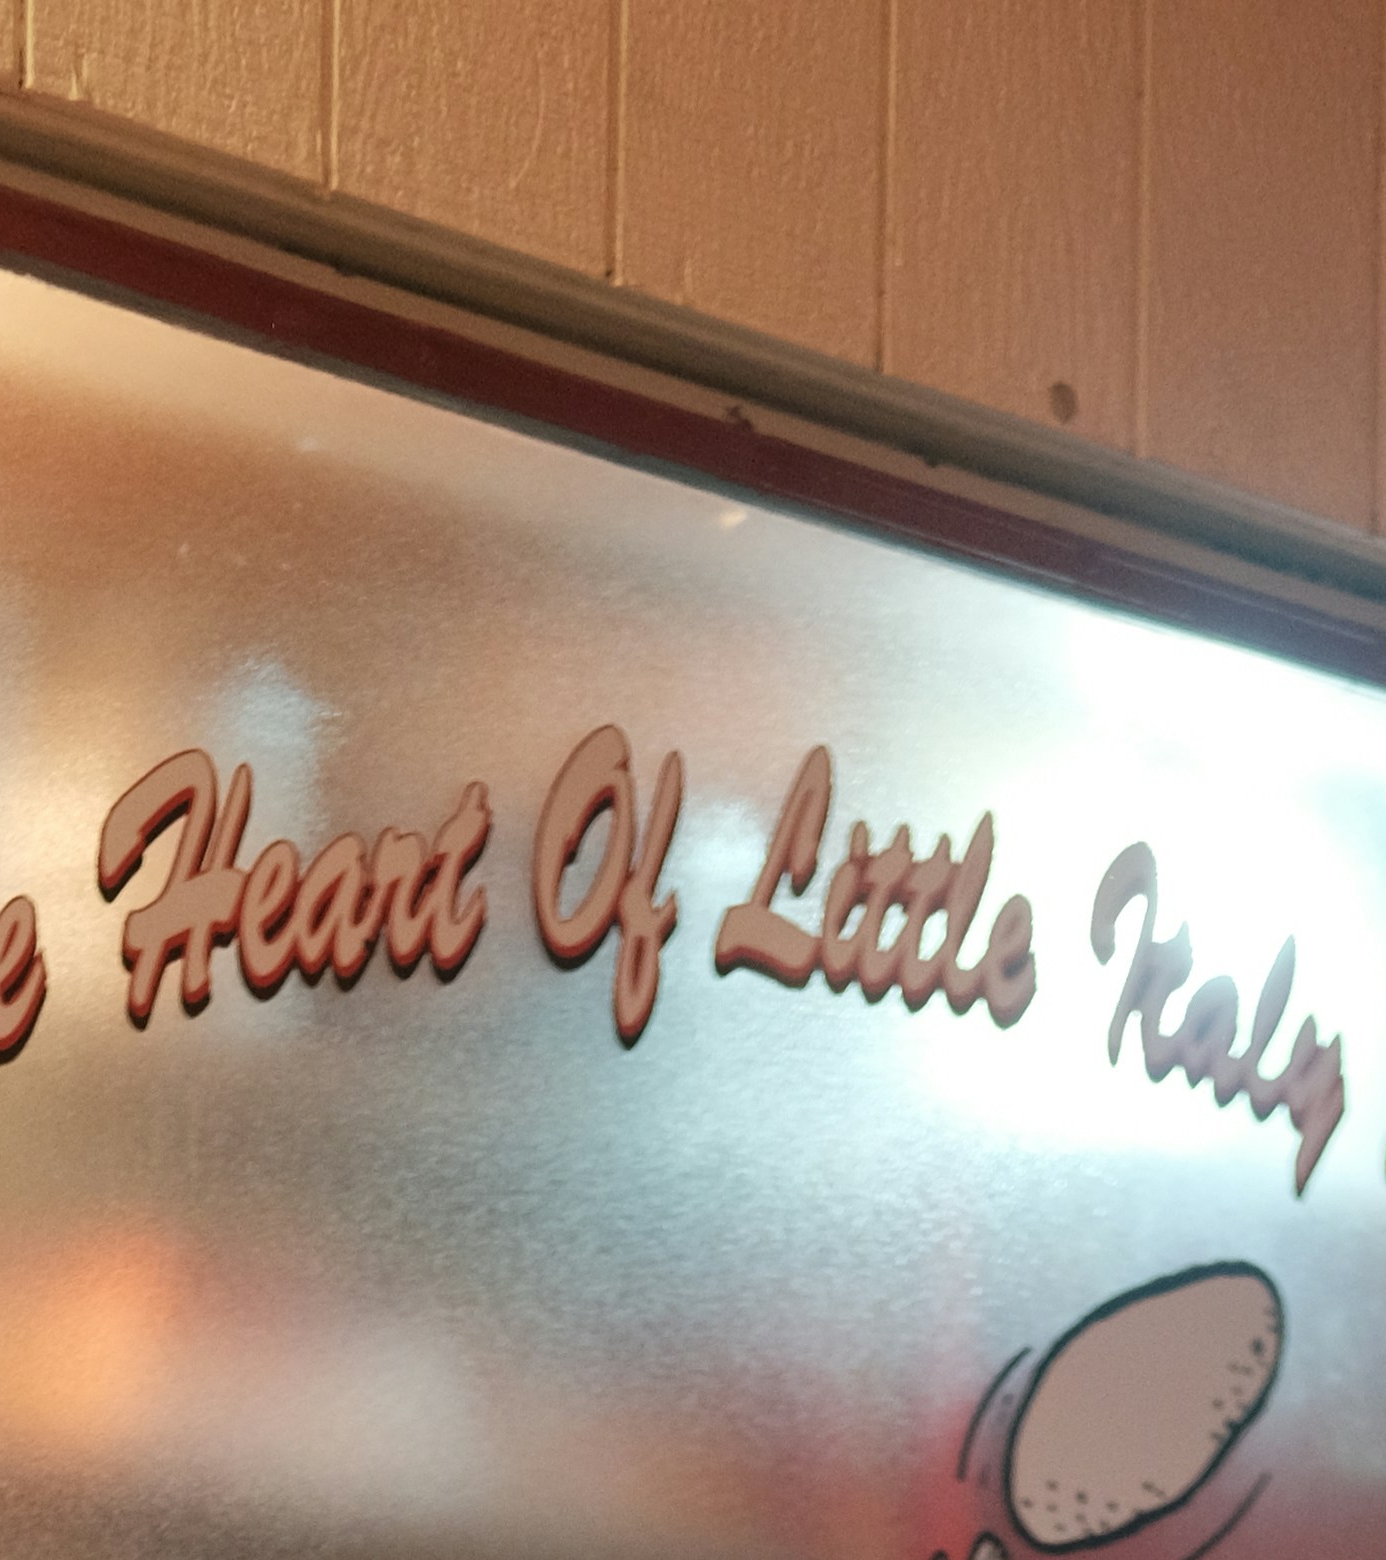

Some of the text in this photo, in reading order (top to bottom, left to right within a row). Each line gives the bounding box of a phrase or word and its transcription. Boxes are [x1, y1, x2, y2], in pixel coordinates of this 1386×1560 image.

[97, 748, 492, 1031] Heart
[531, 723, 681, 1049] Of
[714, 744, 1037, 1032] Little
[1090, 840, 1345, 1199] Italy
